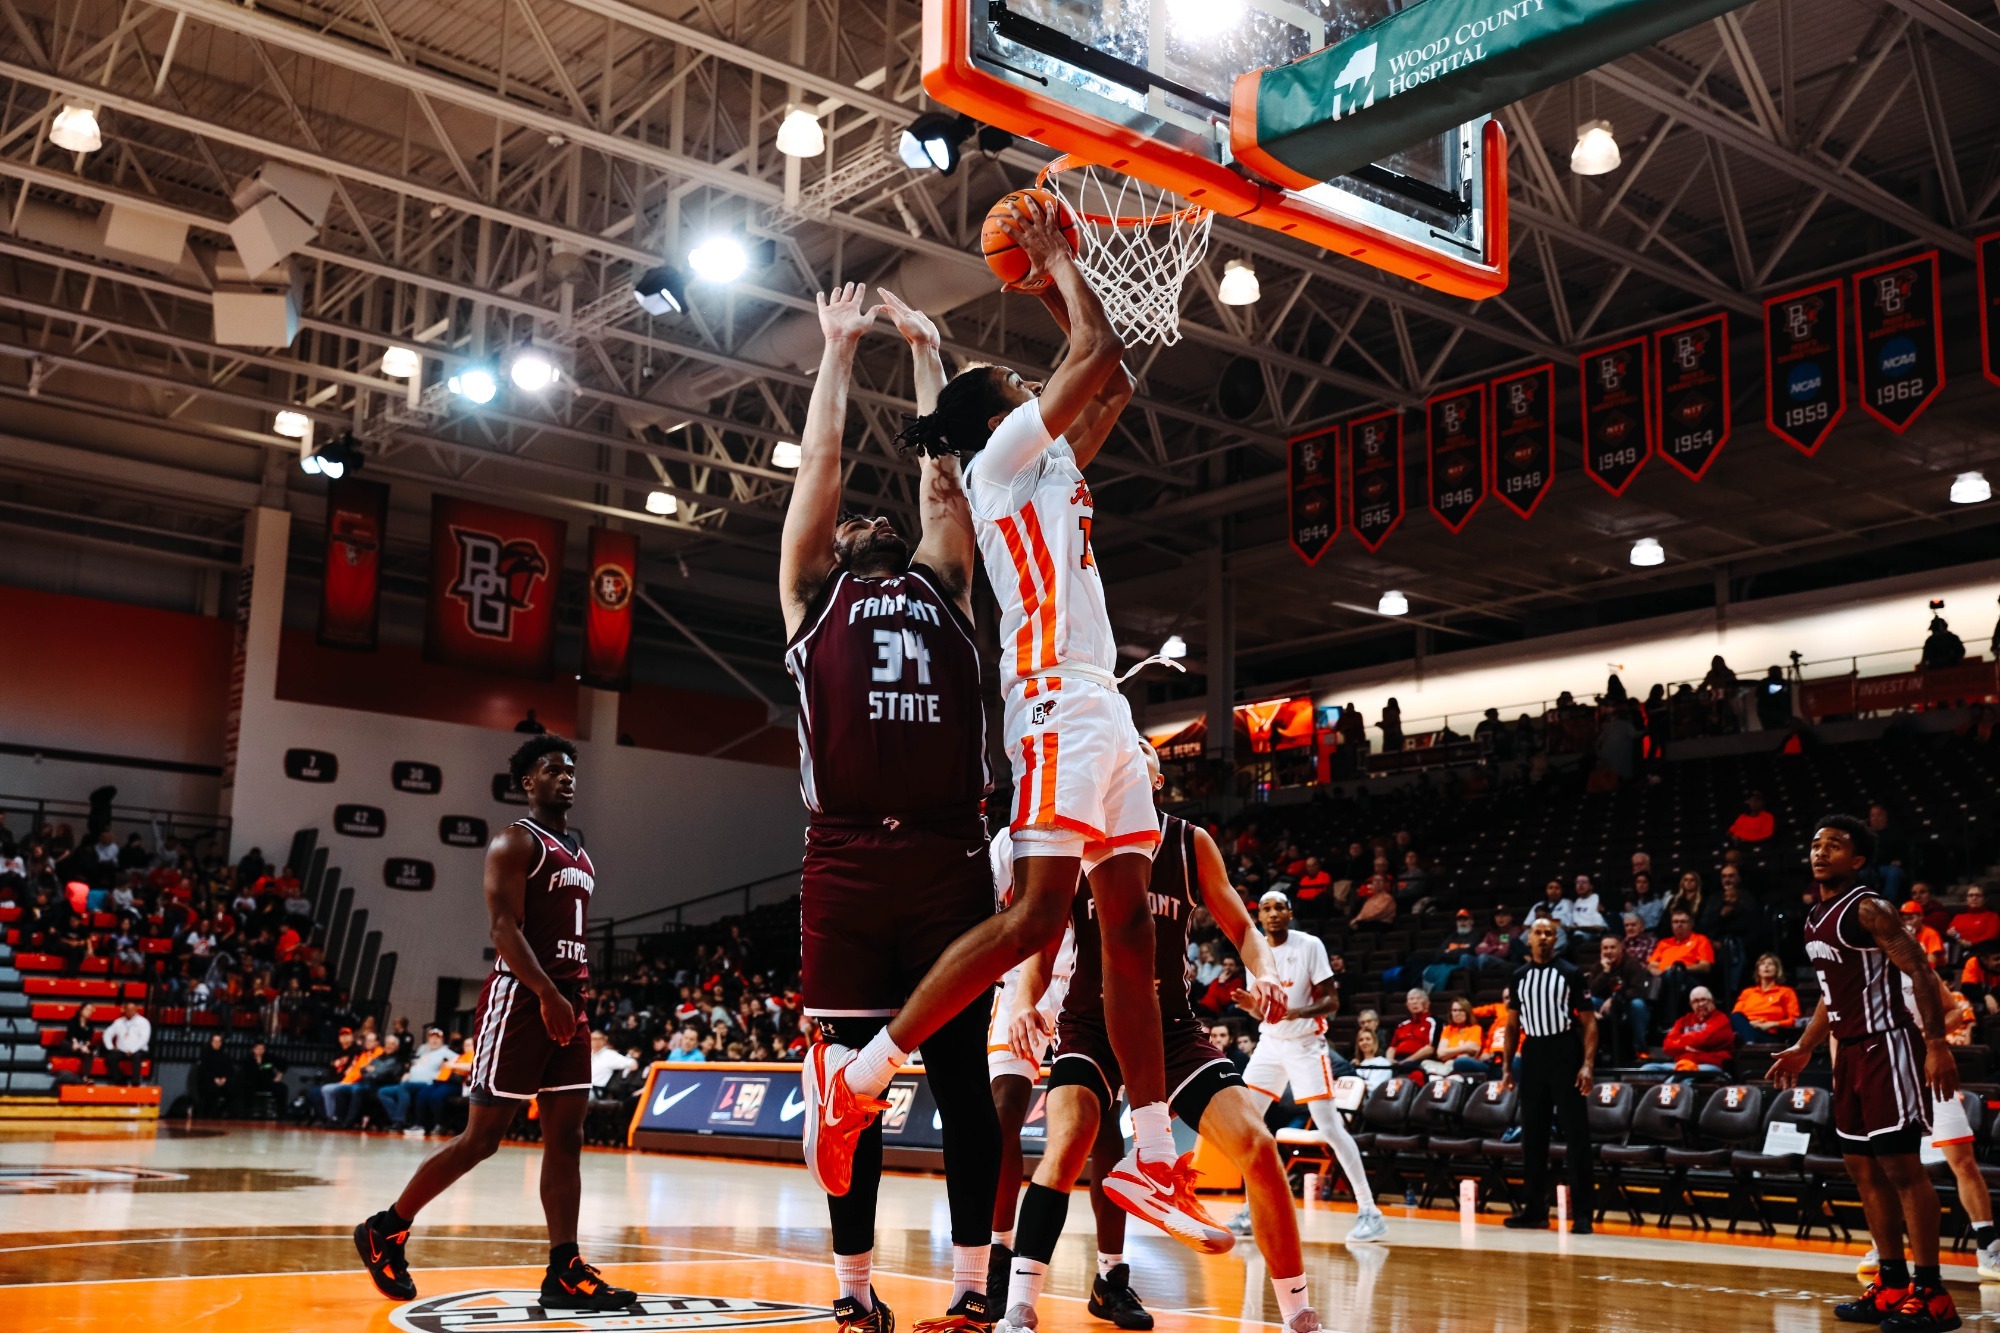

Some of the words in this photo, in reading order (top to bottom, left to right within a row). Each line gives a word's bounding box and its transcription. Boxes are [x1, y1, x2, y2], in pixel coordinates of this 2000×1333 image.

[1388, 36, 1450, 75] WOOD
[1455, 0, 1544, 46] COUNTY
[1388, 43, 1487, 98] HOSPITAL
[1881, 352, 1917, 371] NCAA
[1788, 376, 1822, 395] NCAA
[1876, 377, 1924, 406] 1962
[1785, 401, 1828, 427] 1959
[1674, 429, 1714, 454] 1954
[1598, 447, 1637, 471] 1949
[1506, 471, 1542, 494] 1948
[1440, 487, 1474, 510] 1946
[1360, 507, 1391, 529] 1945
[1299, 524, 1329, 544] 1944
[871, 628, 932, 685] 34
[868, 690, 941, 723] STATE
[575, 898, 583, 937] 1
[1816, 970, 1832, 1006] 5
